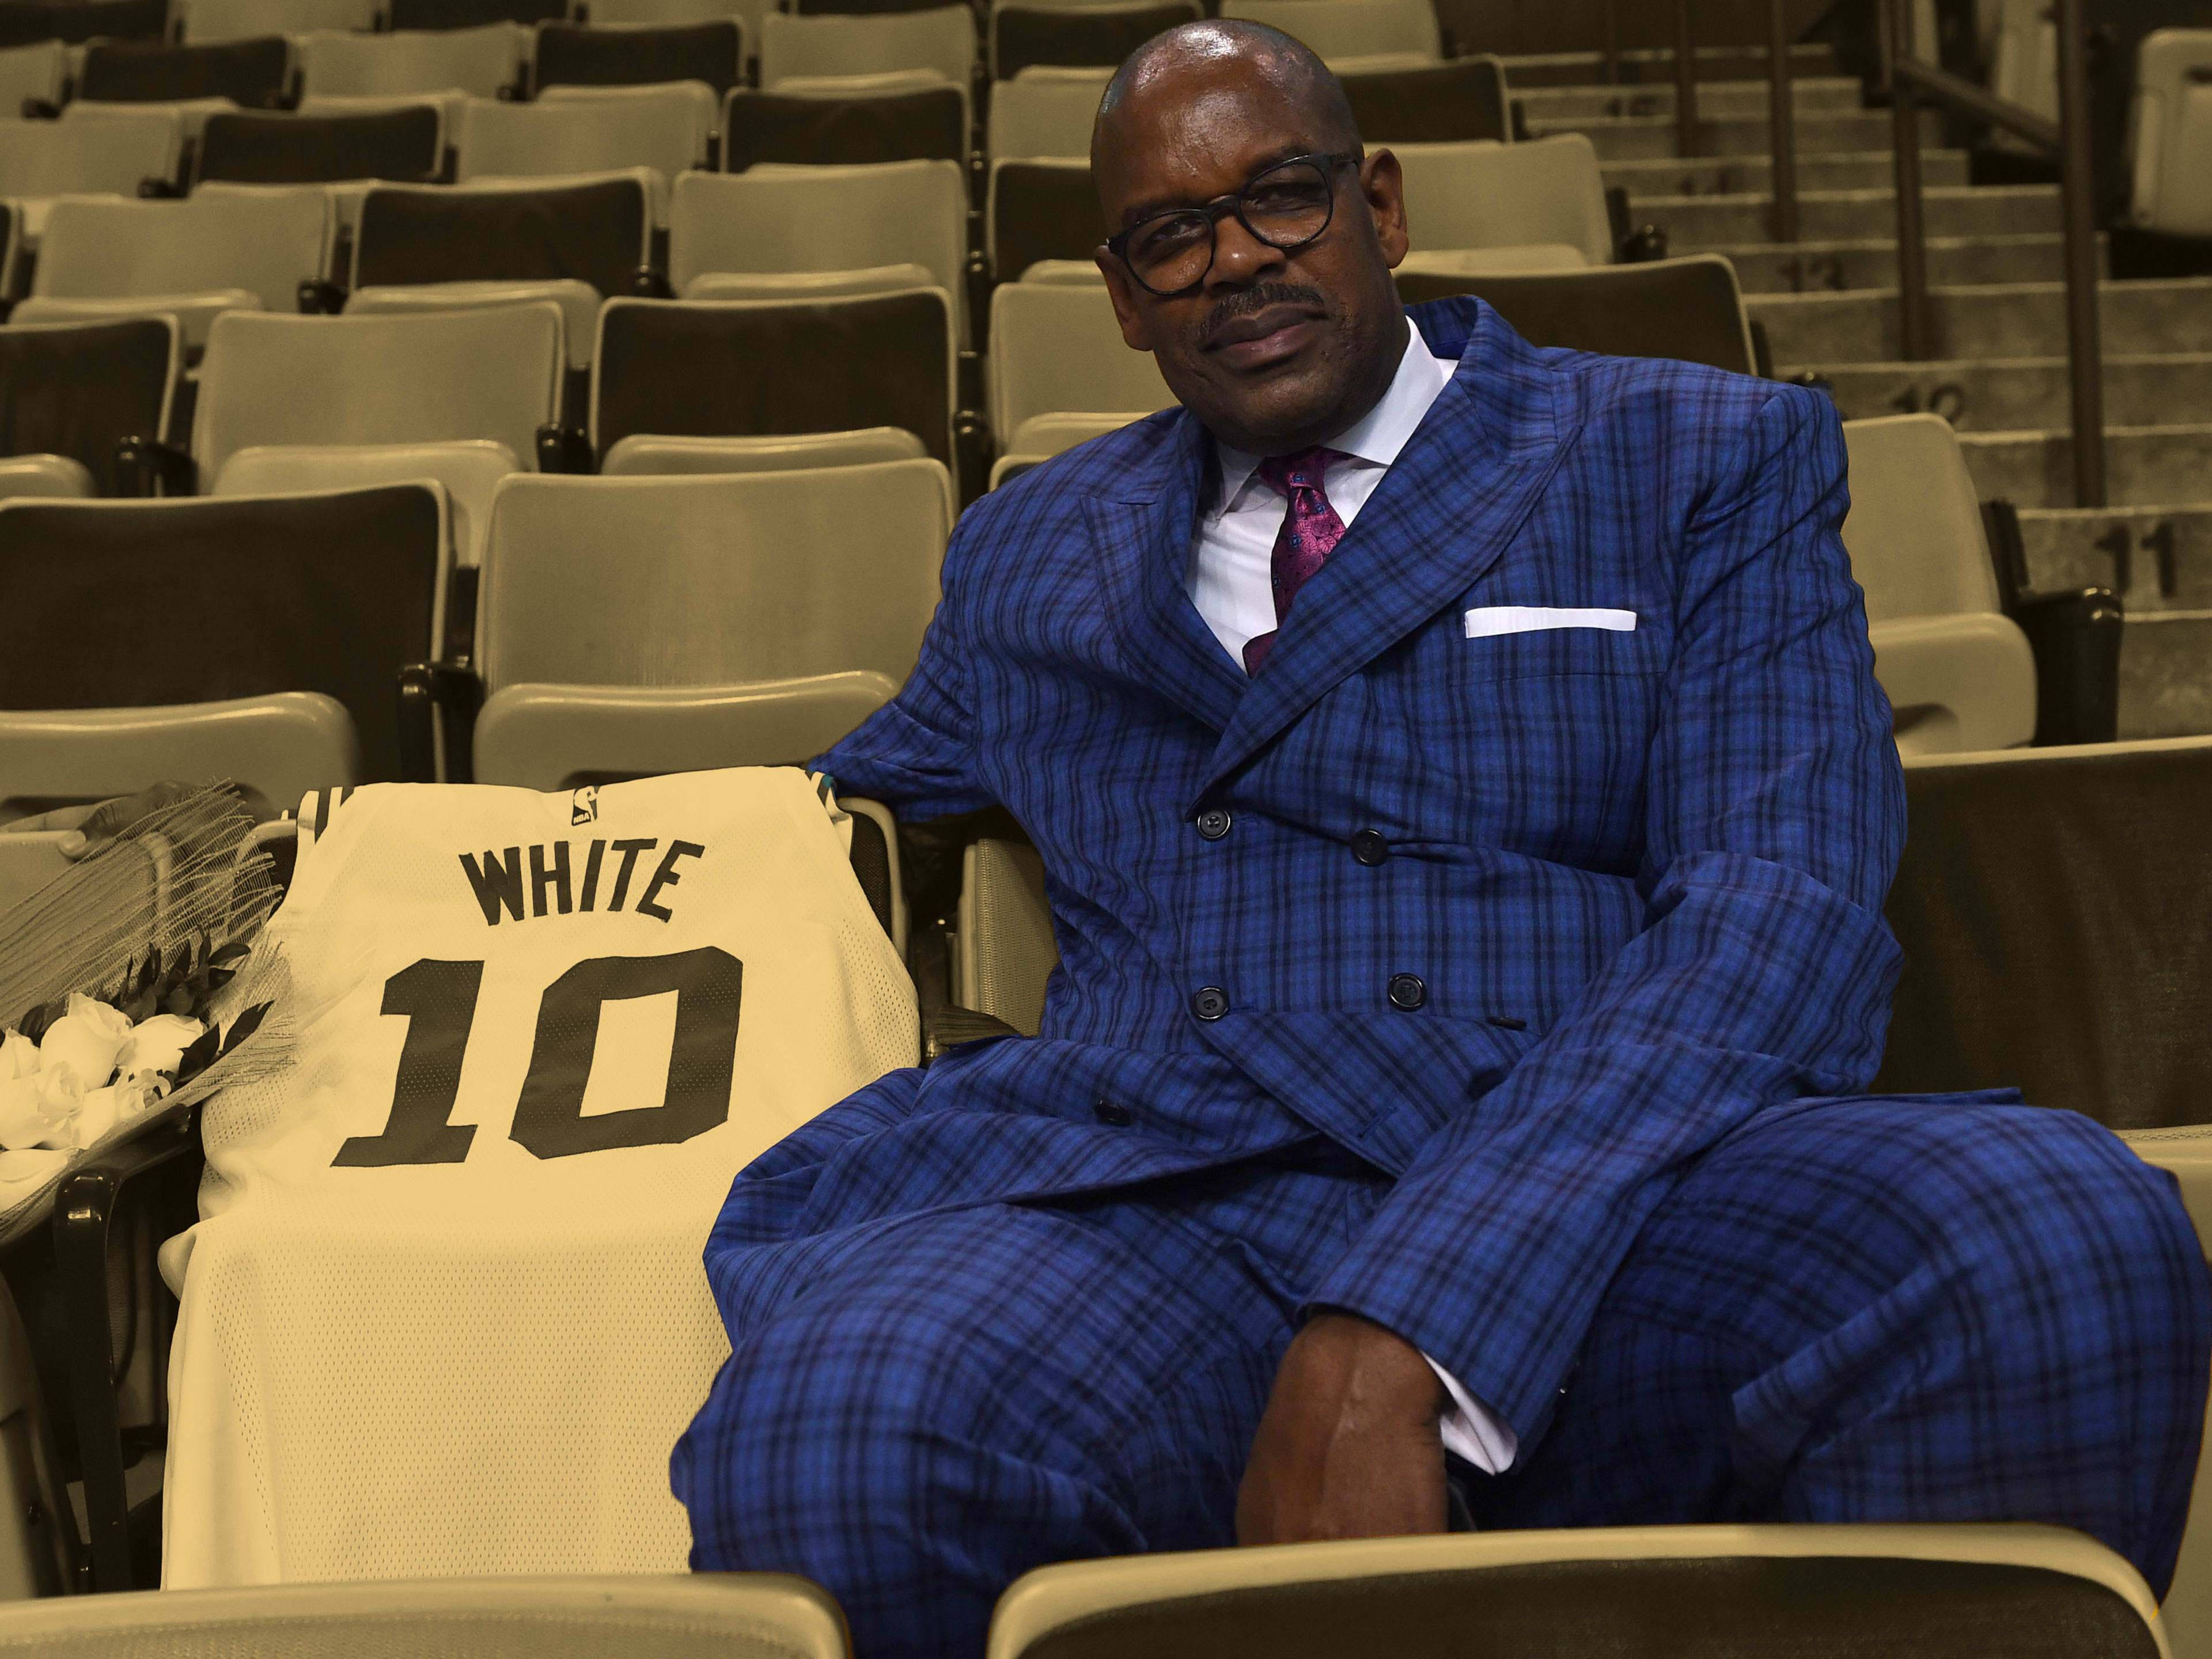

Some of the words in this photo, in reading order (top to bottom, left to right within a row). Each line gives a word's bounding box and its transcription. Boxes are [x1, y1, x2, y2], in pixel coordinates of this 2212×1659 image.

[2096, 523, 2176, 598] 11
[573, 812, 590, 824] NBA
[459, 838, 705, 926] WHITE
[329, 946, 743, 1168] 10
